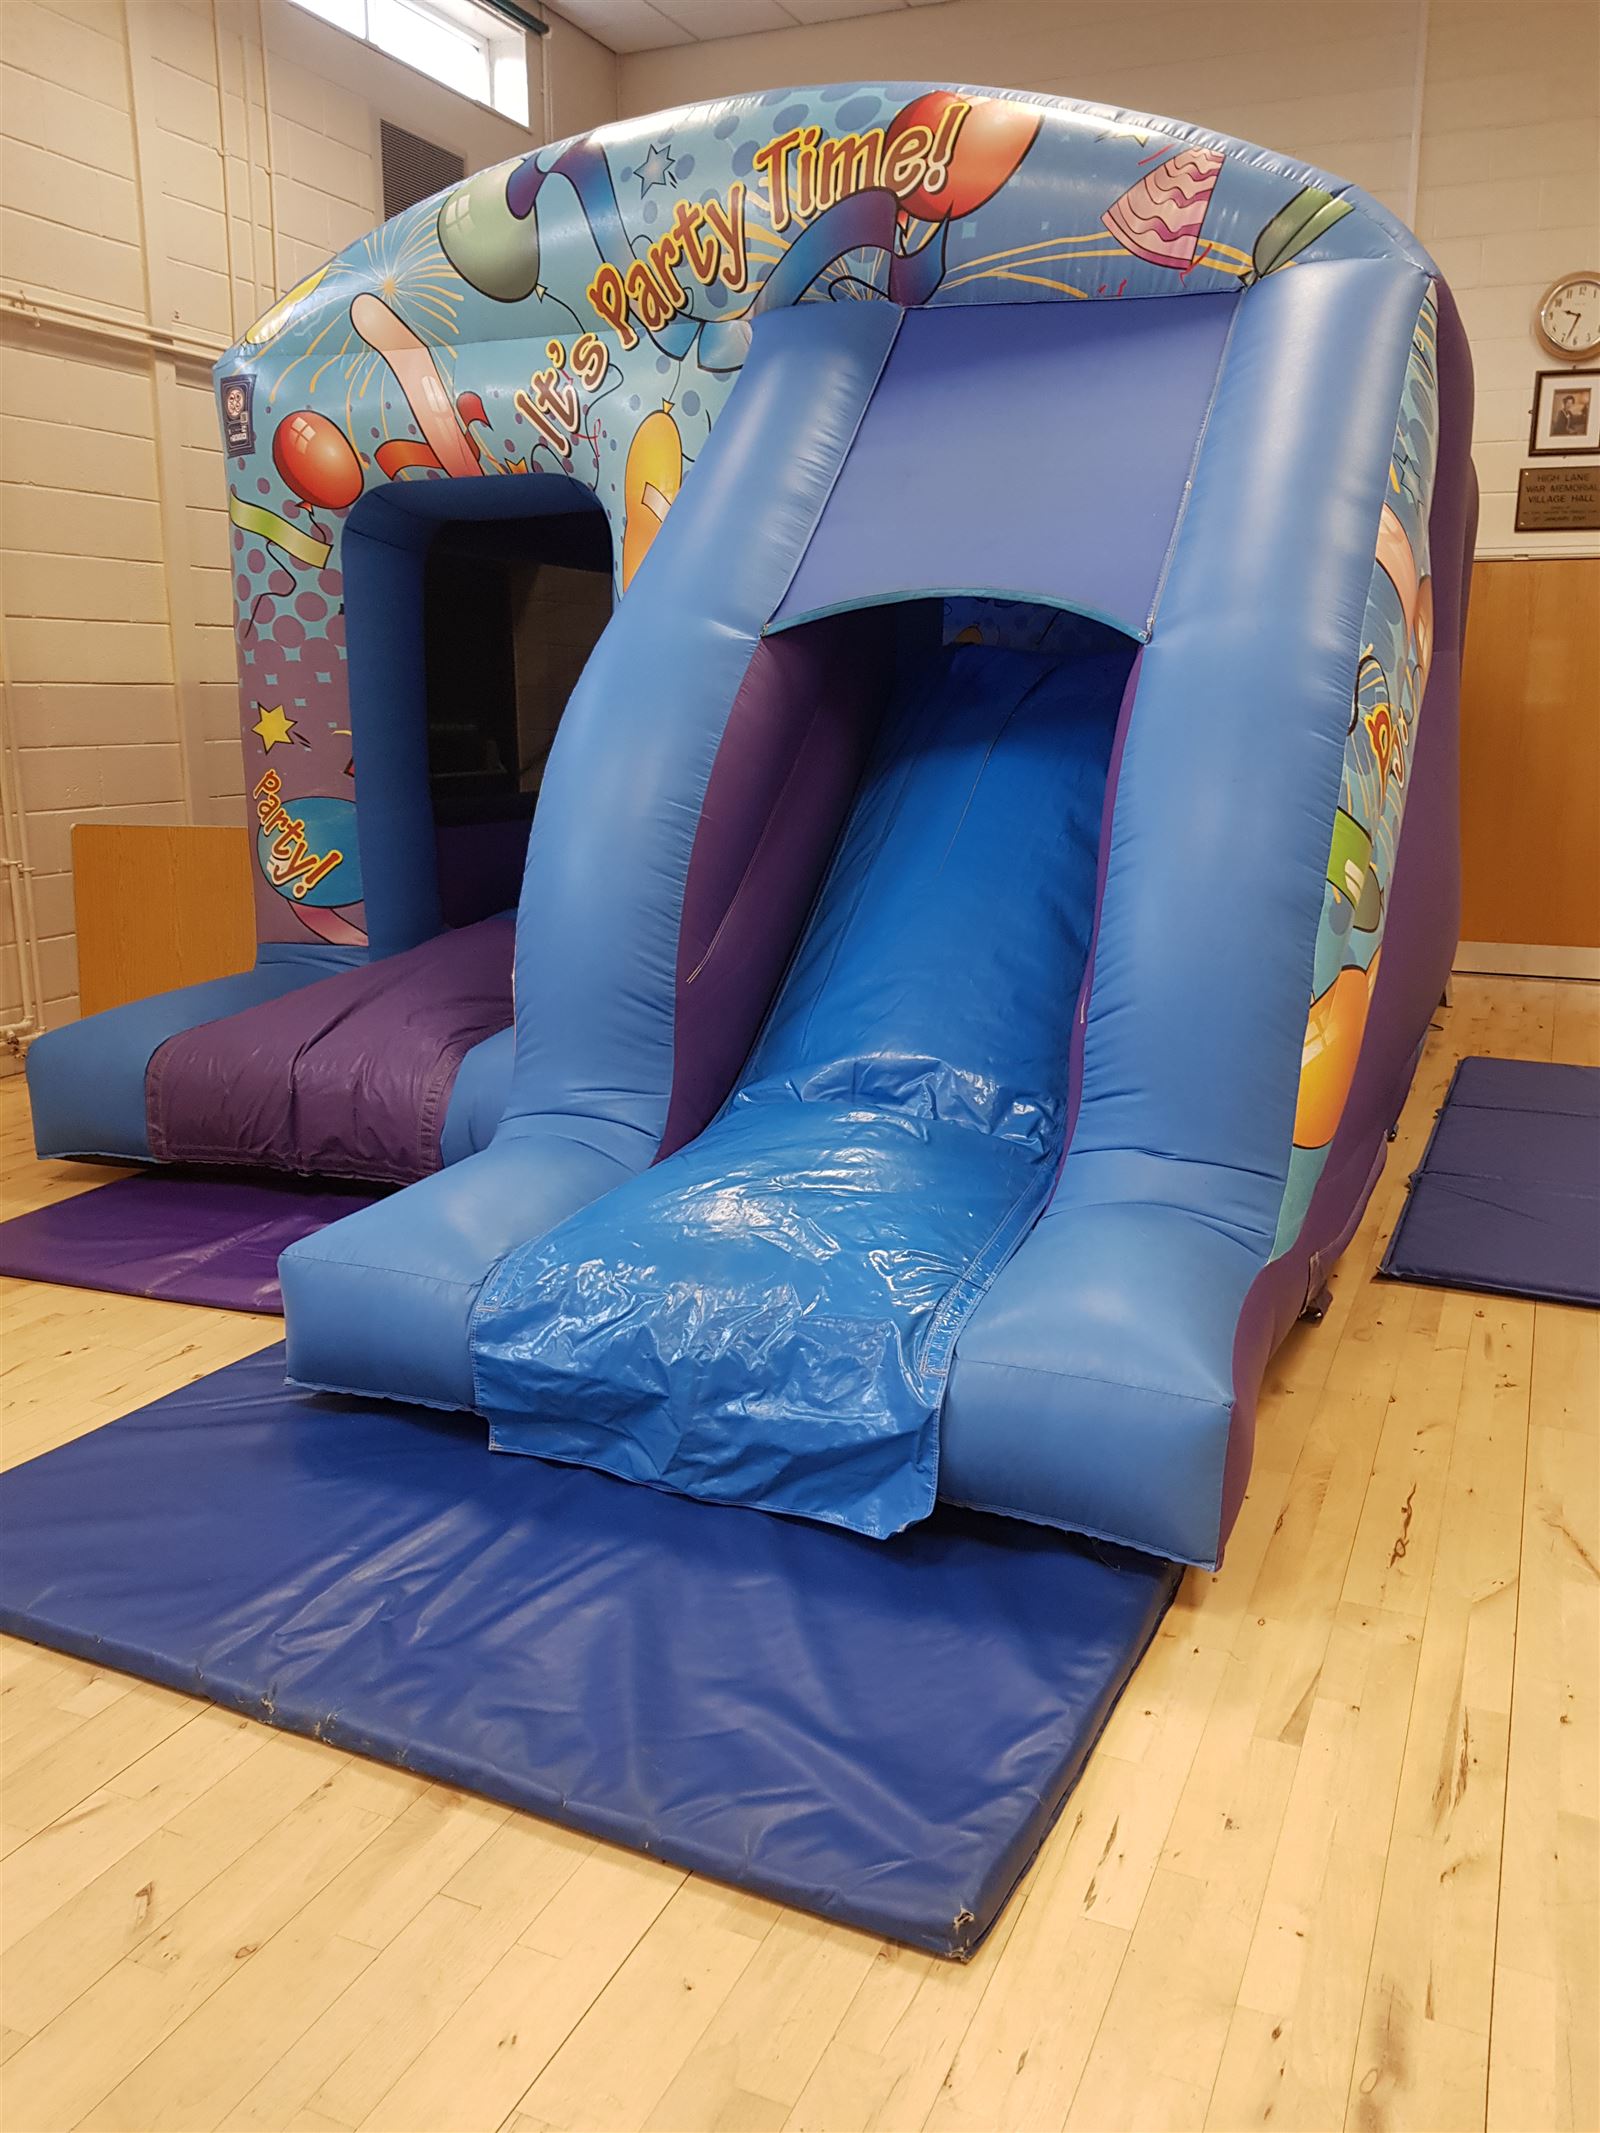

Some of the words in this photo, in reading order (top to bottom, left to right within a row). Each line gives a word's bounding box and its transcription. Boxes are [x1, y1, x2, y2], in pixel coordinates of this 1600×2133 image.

[514, 332, 609, 457] It's
[586, 181, 749, 352] Party
[752, 101, 970, 233] Time!
[1537, 474, 1560, 482] HIGH
[1564, 473, 1590, 482] LANE
[1525, 485, 1546, 493] WAR
[1528, 495, 1566, 503] VILLAGE
[1571, 494, 1595, 503] HALL
[253, 768, 343, 900] Party!
